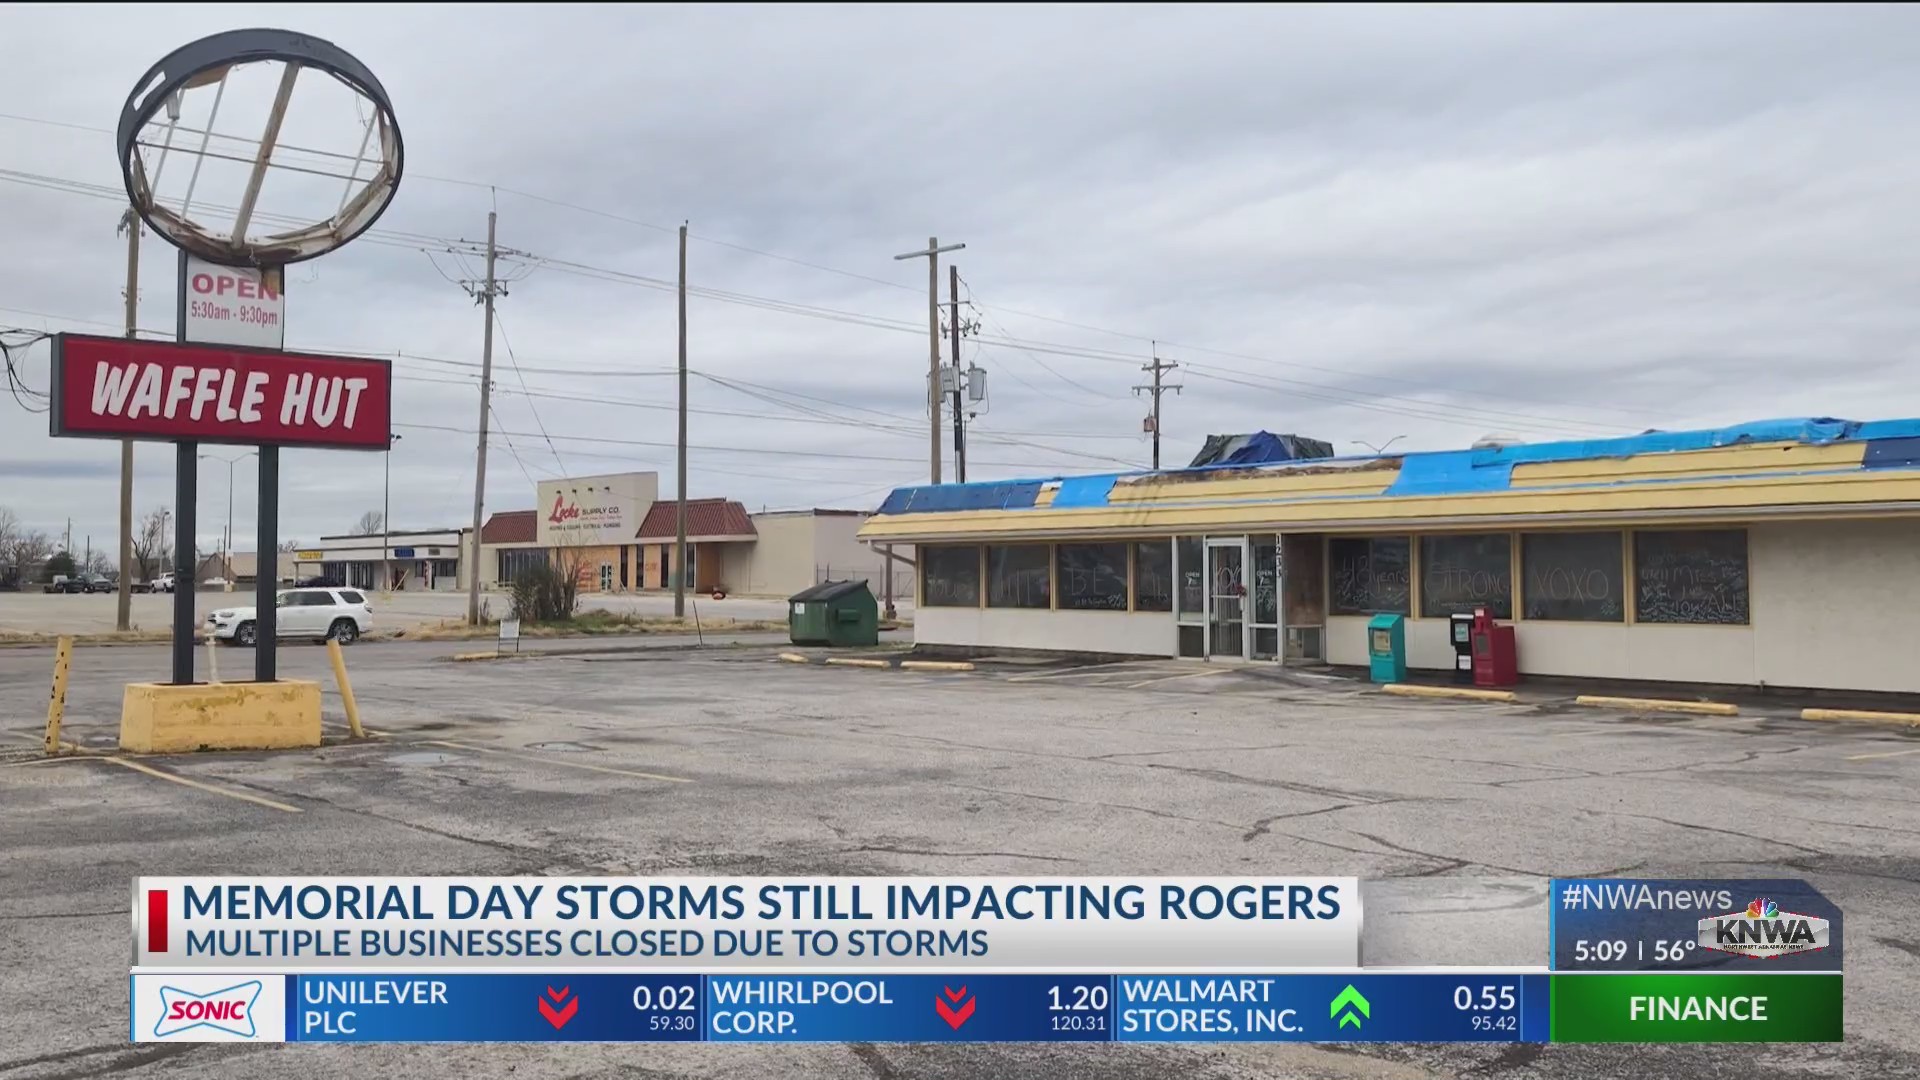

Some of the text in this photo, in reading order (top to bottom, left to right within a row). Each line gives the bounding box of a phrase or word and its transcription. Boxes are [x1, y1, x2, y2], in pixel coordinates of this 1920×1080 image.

[191, 273, 278, 301] OPEN
[191, 301, 230, 321] 5:30am
[239, 305, 278, 326] 9:30pm
[91, 361, 368, 429] WAFFLE HUT
